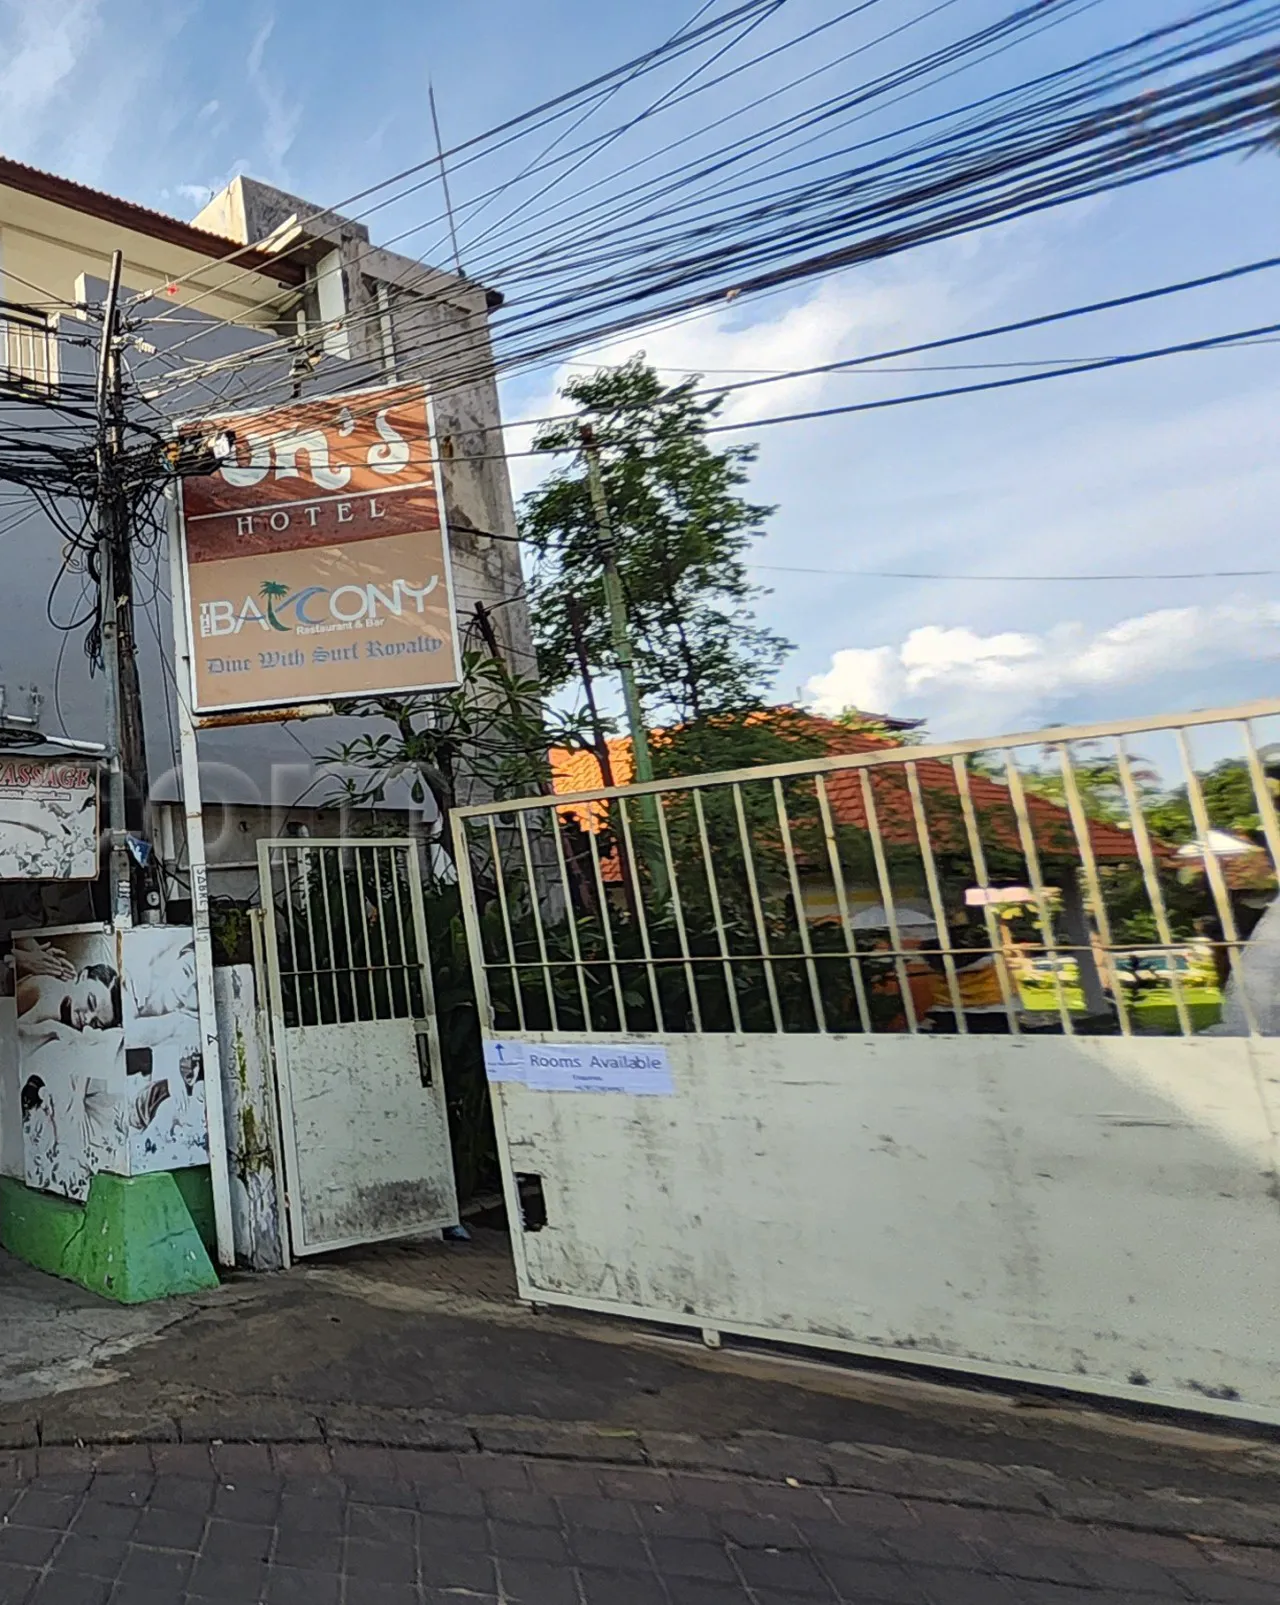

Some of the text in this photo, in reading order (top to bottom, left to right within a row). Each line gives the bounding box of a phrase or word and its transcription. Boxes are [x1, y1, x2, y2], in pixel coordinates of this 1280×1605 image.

[236, 499, 386, 537] HOTEL
[199, 602, 213, 638] THE
[296, 620, 354, 636] Restaurant
[366, 616, 385, 628] Bar
[206, 635, 443, 674] Dine With Surf Royalty
[529, 1054, 662, 1070] Rooms Available
